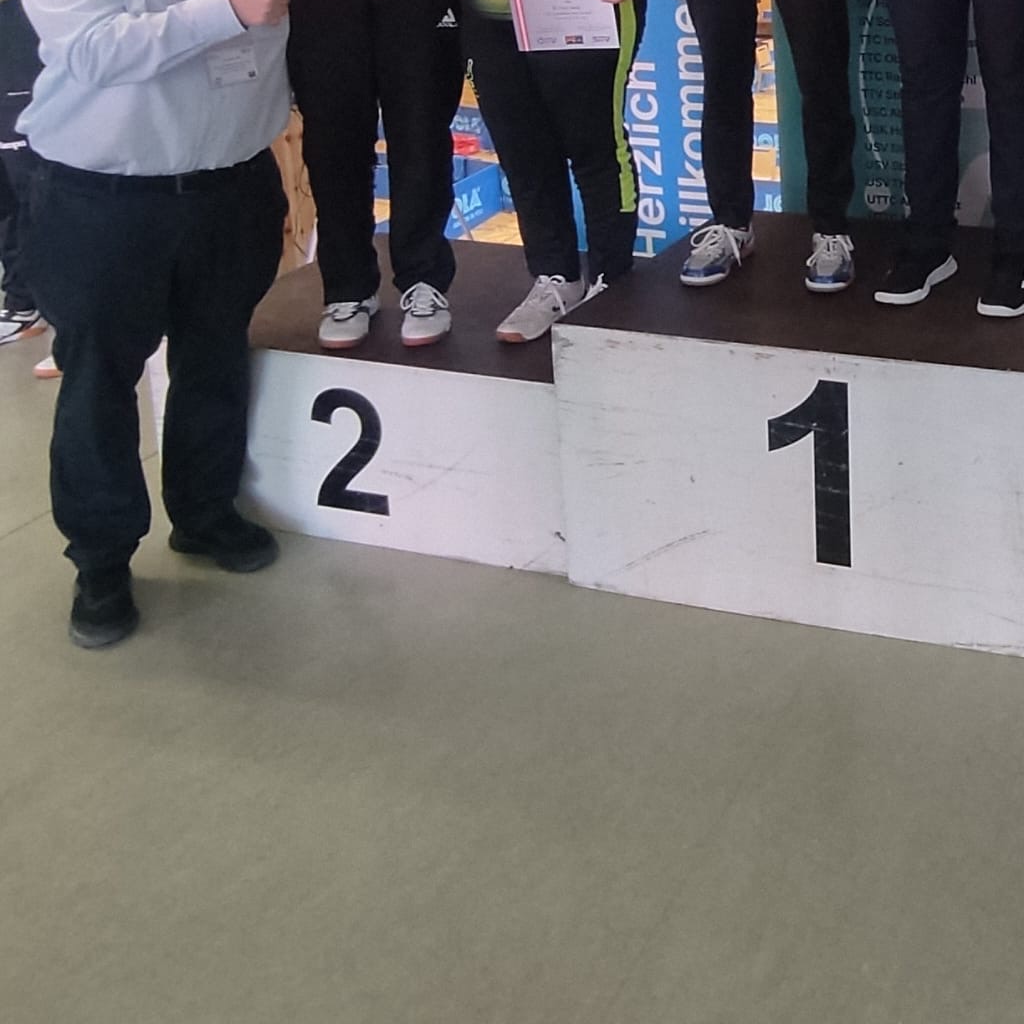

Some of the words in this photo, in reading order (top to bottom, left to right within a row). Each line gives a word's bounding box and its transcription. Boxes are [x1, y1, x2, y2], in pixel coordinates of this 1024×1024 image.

[626, 61, 667, 258] Herzlich
[311, 387, 390, 517] 2
[767, 379, 852, 568] 1
